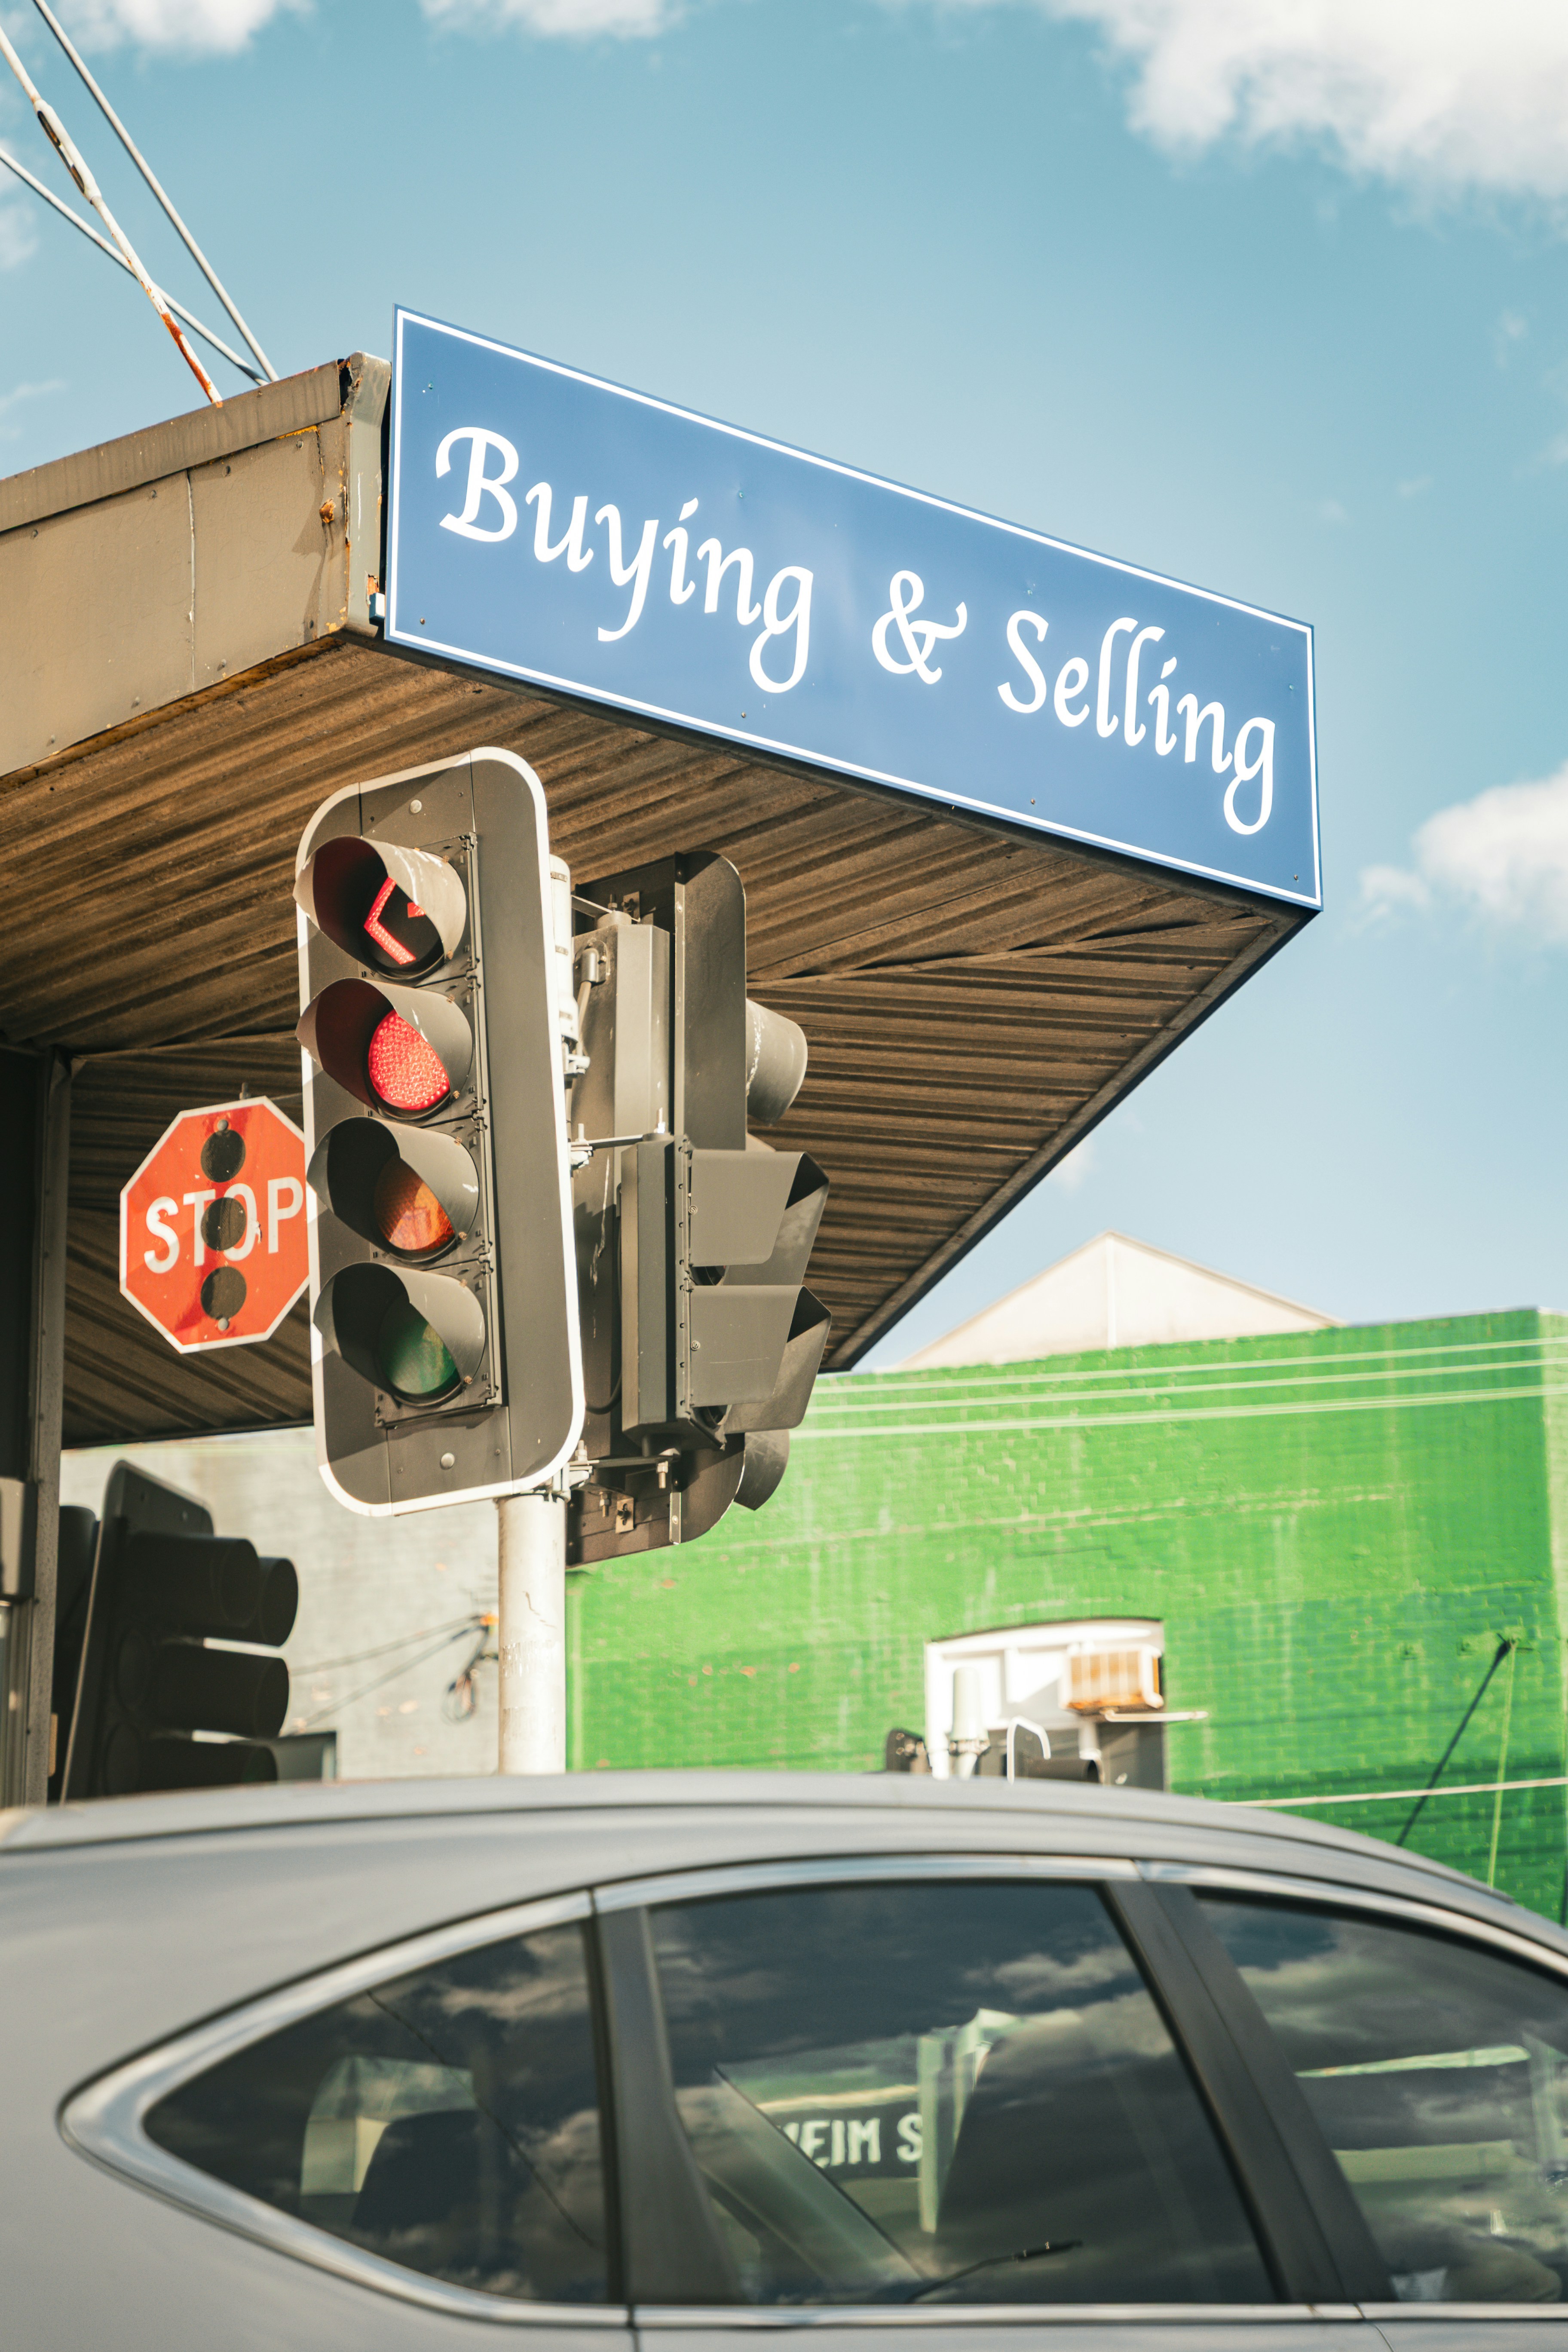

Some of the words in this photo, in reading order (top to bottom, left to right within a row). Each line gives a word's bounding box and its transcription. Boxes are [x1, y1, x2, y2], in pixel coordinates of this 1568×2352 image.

[435, 426, 815, 695] Buying
[871, 570, 968, 686] &
[997, 609, 1276, 836] Selling
[143, 1176, 304, 1274] STOP
